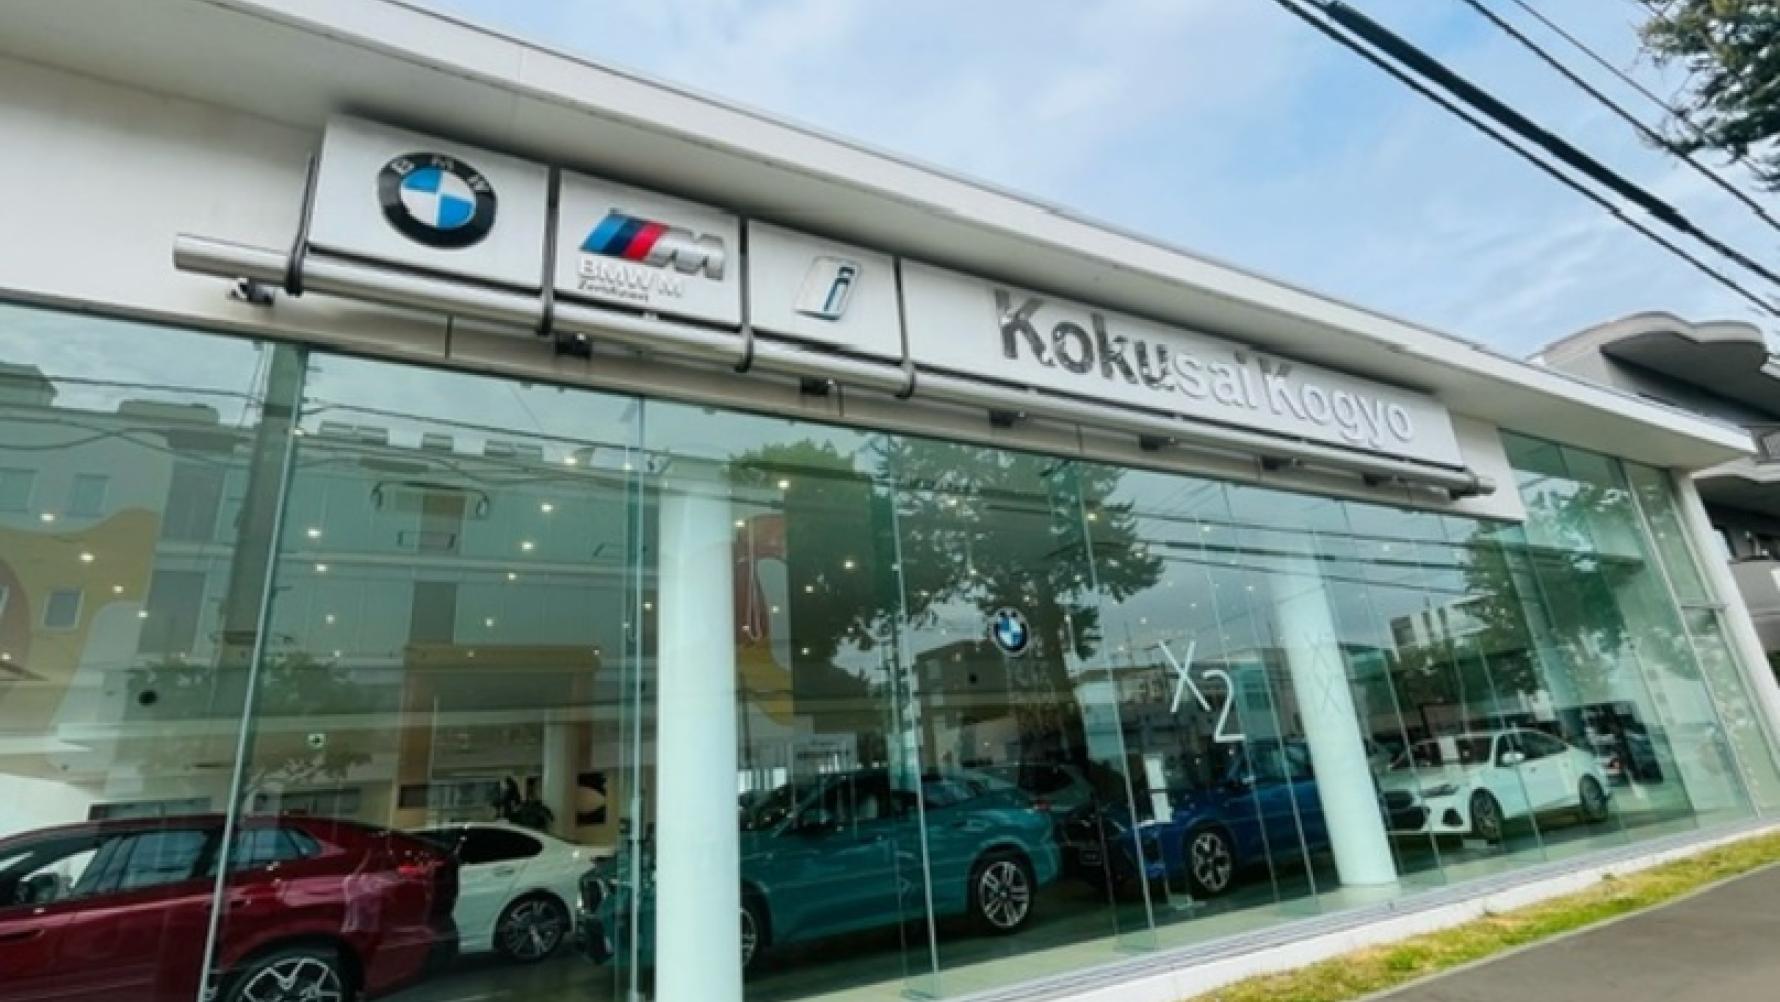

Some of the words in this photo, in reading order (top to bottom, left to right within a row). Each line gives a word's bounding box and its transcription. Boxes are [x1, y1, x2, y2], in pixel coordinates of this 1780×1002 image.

[578, 257, 651, 290] BMW
[995, 288, 1257, 409] Kokusai
[1257, 357, 1413, 449] Kogyo
